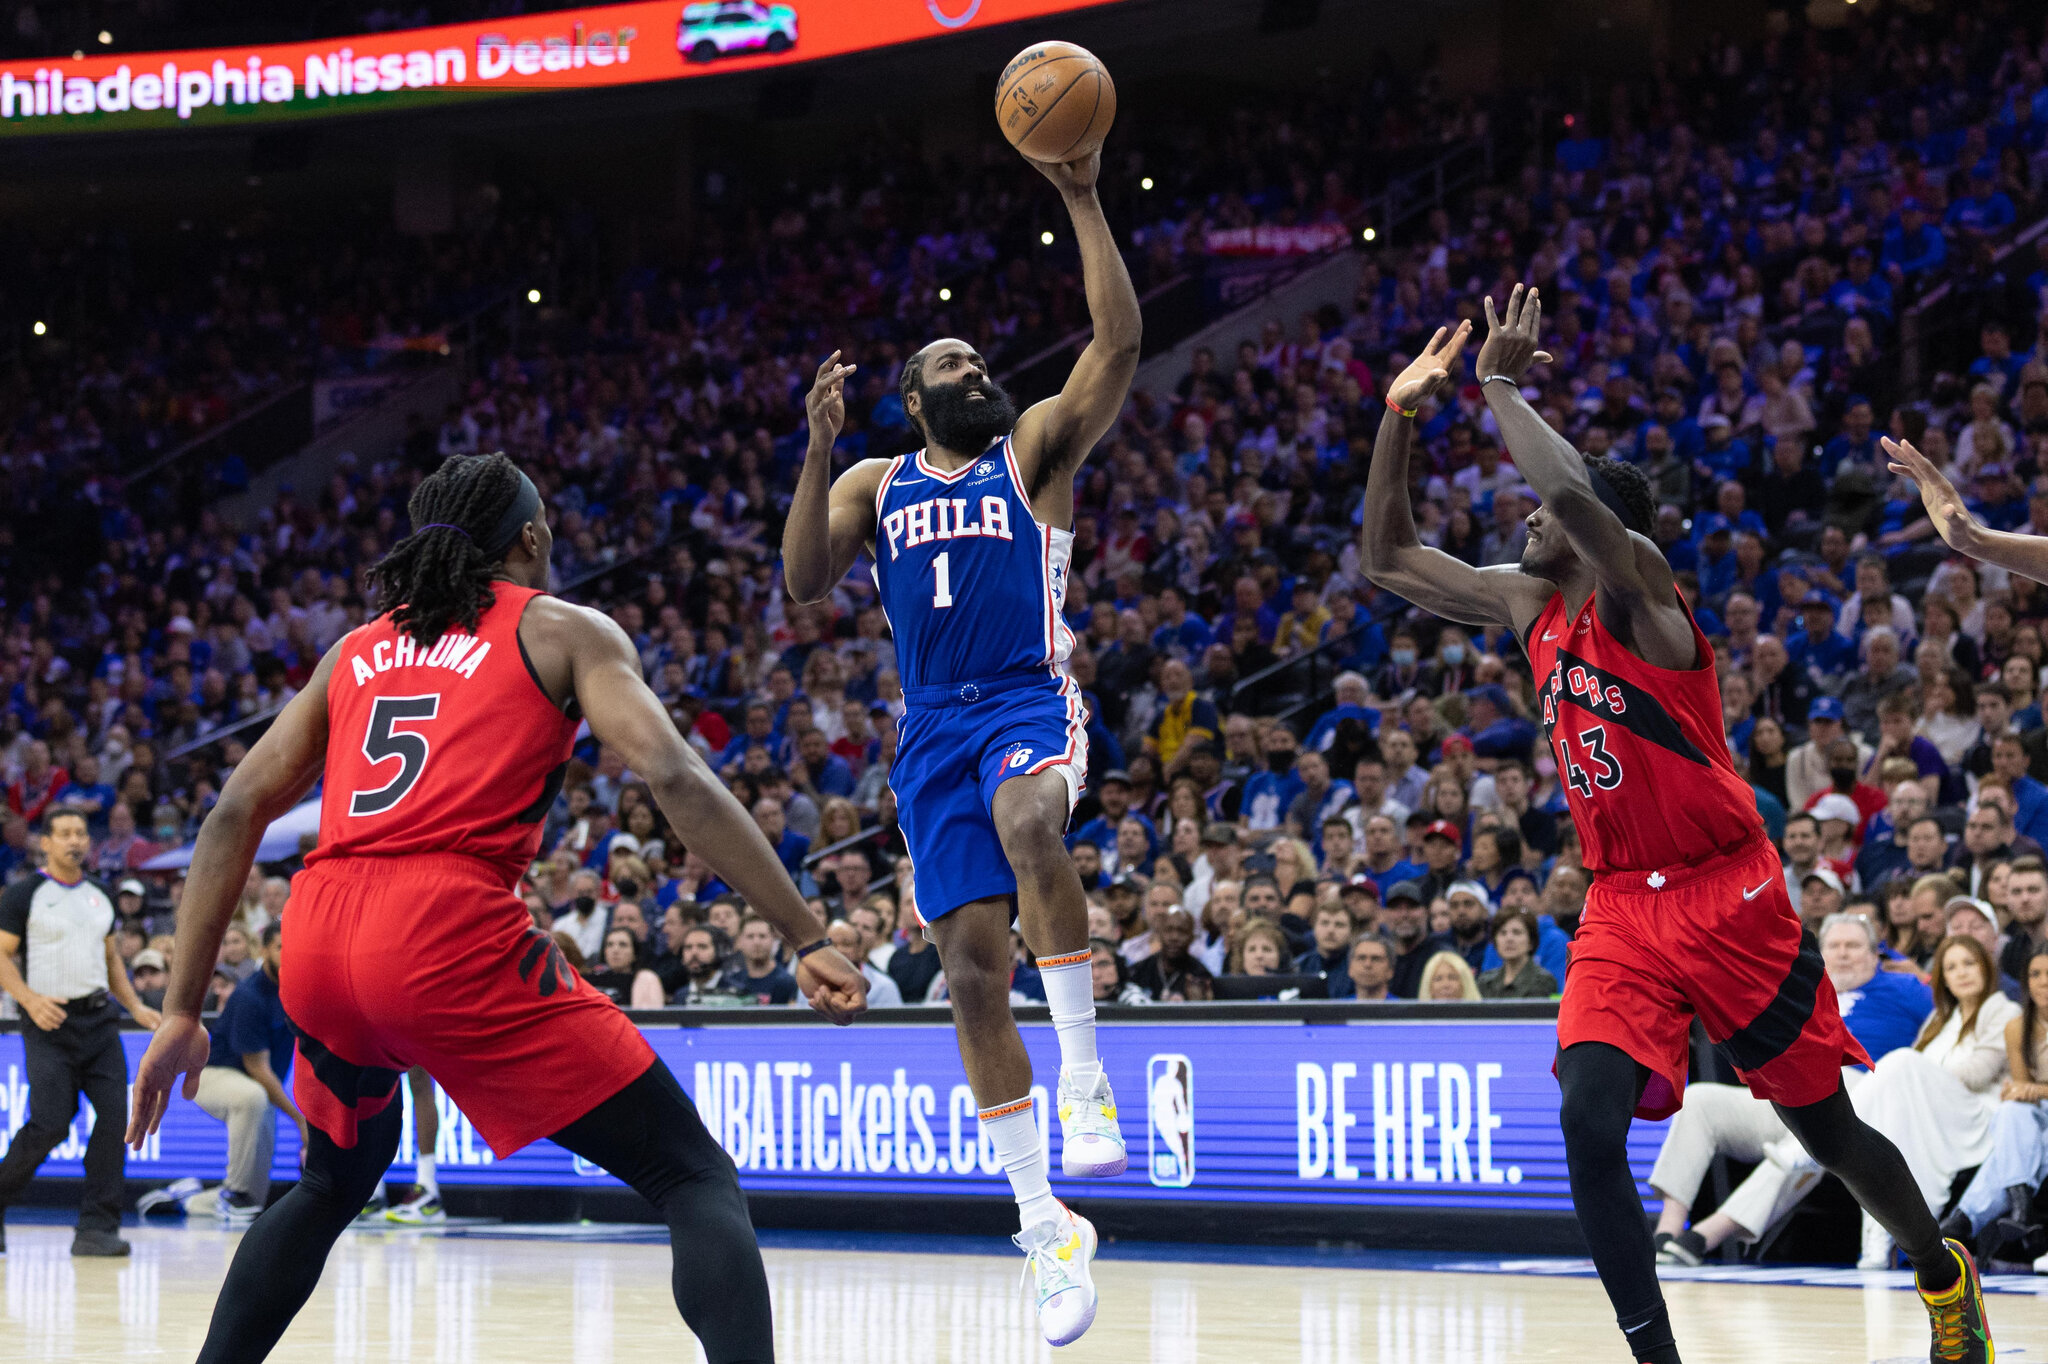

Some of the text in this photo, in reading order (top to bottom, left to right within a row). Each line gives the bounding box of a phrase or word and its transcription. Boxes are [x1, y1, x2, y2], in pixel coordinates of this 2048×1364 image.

[0, 20, 638, 119] hiladelphia Nissan Dealer
[967, 472, 1005, 487] crypto.com
[882, 495, 1013, 562] PHILA
[932, 552, 953, 609] 1
[351, 634, 492, 687] ACHIUWA
[348, 693, 441, 817] 5
[1560, 725, 1623, 798] 43
[1296, 1062, 1523, 1185] BE HERE.
